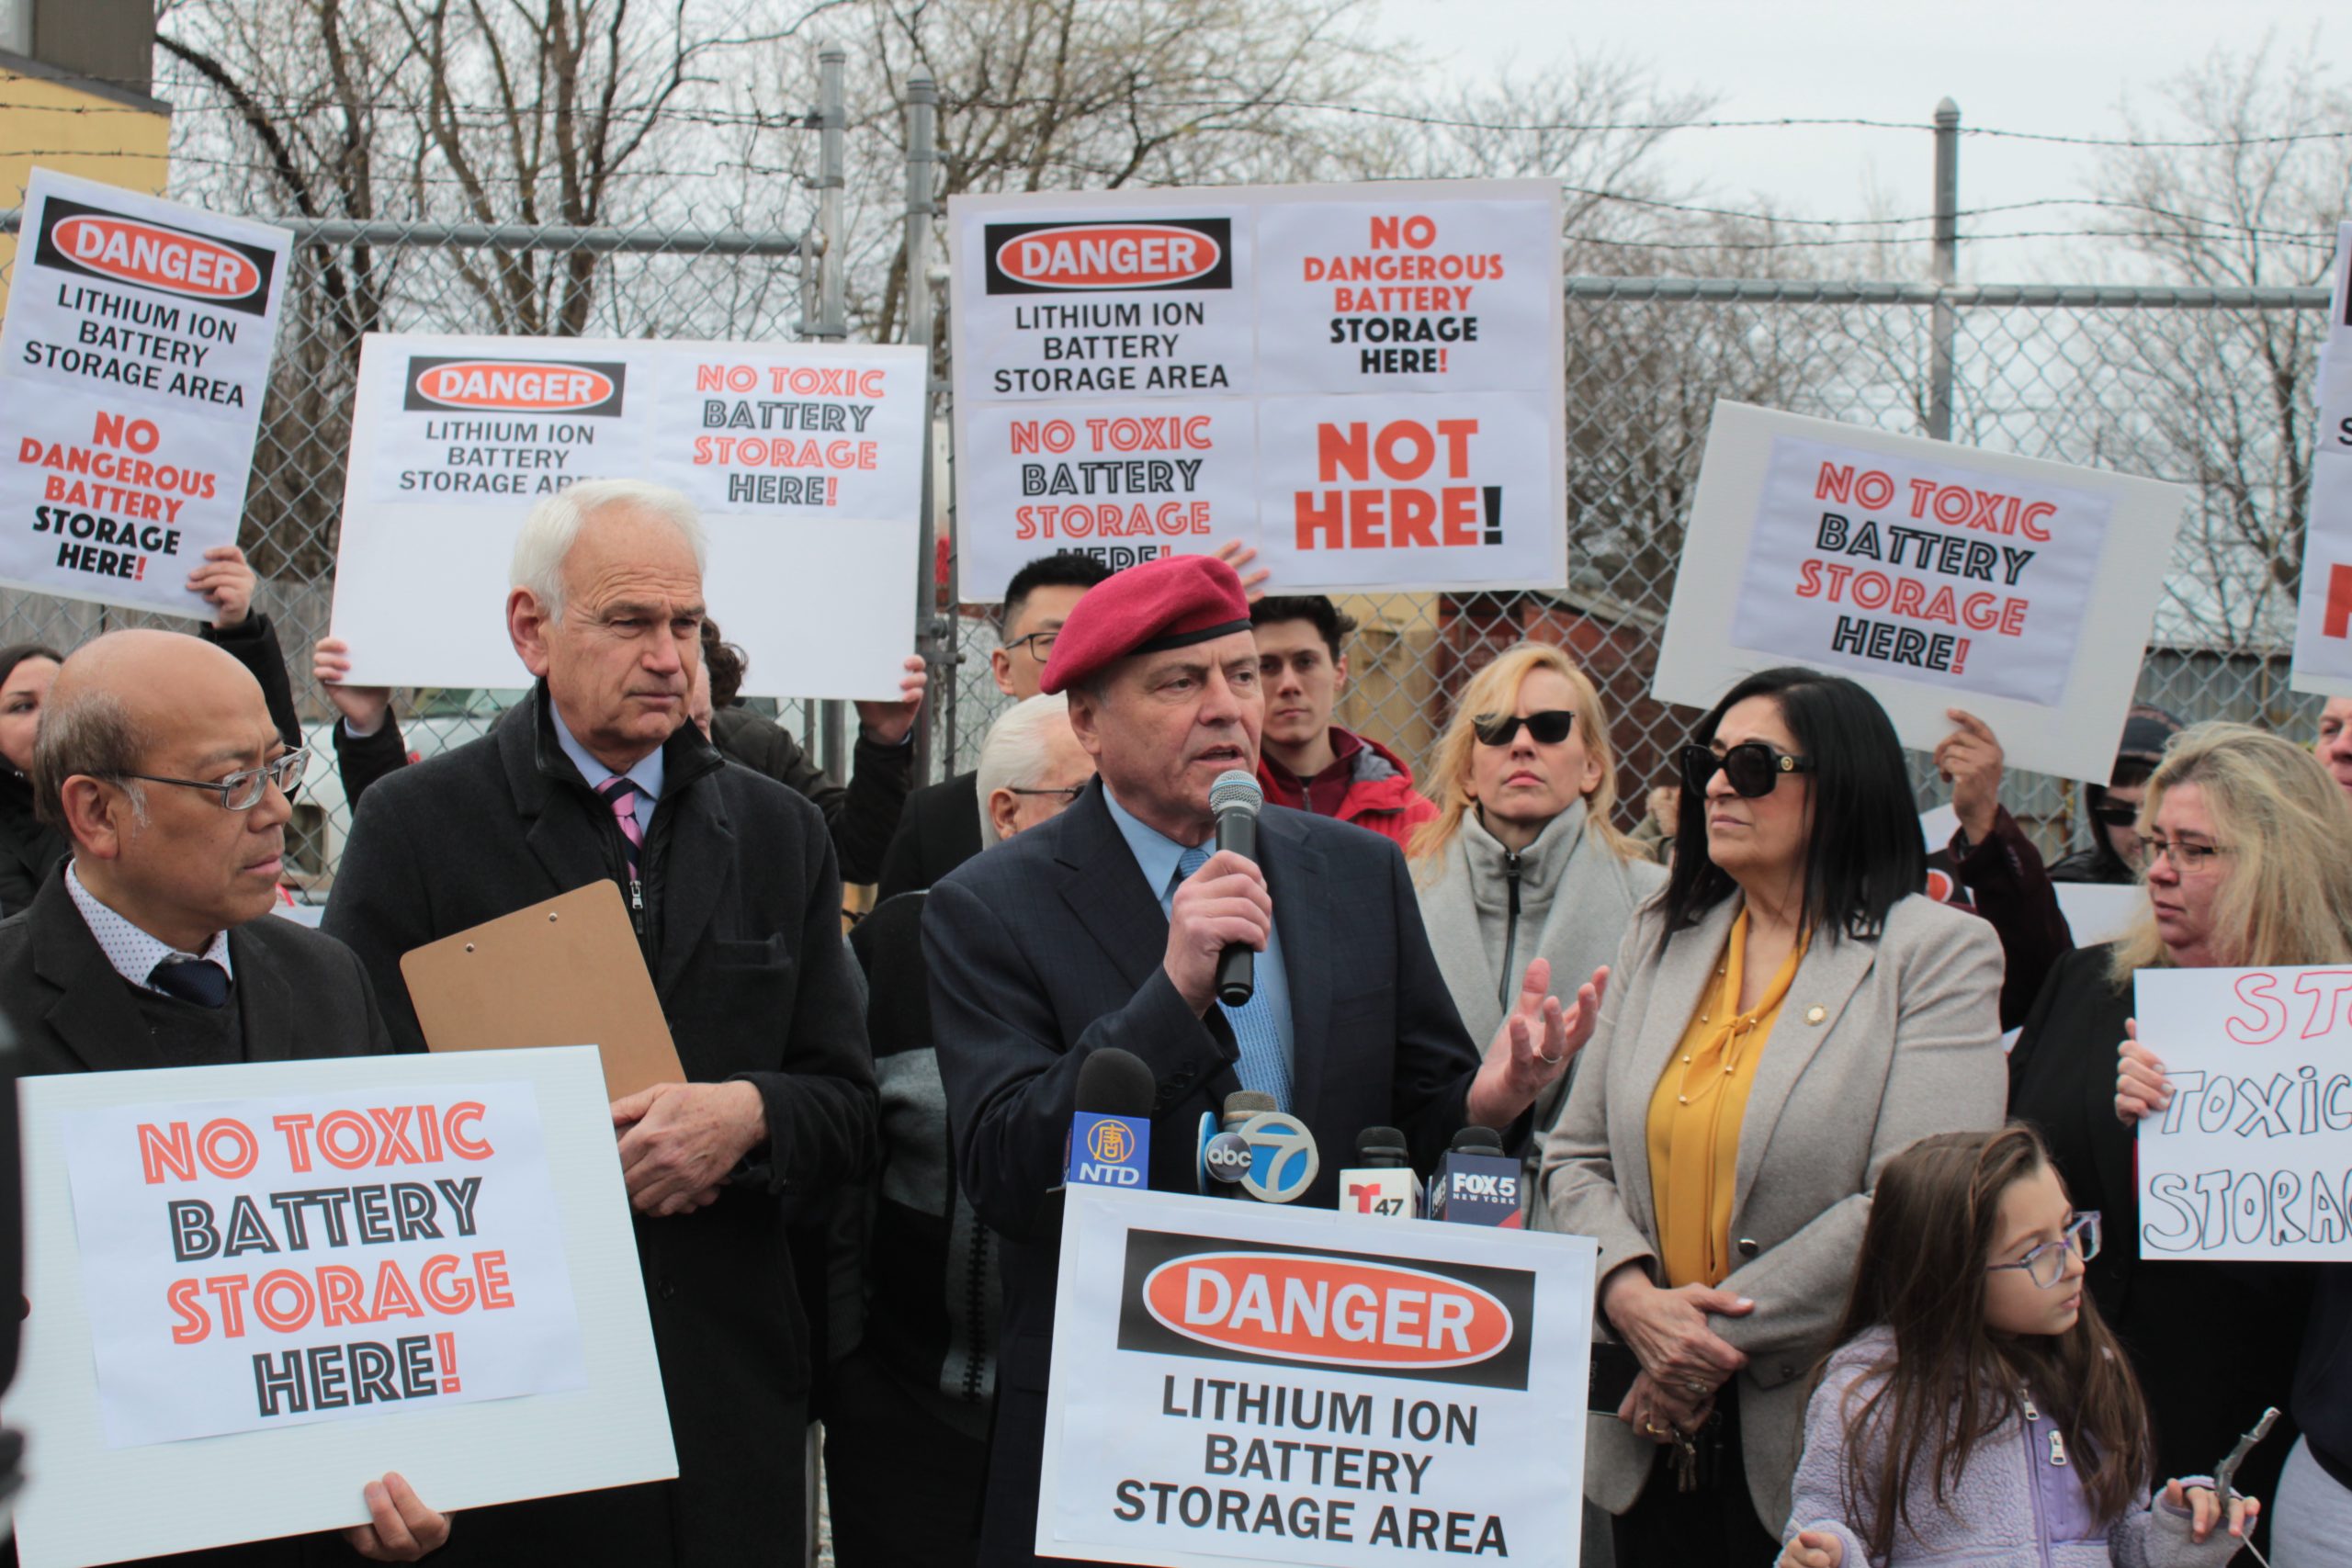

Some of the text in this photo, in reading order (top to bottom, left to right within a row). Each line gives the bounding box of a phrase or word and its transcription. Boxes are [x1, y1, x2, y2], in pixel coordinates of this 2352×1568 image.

[1370, 215, 1436, 250] NO
[74, 222, 241, 292] DANGER
[1021, 239, 1196, 276] DANGER
[1305, 254, 1503, 281] DANGEROUS
[57, 284, 236, 344] LITHIUM ION
[1016, 302, 1204, 329] LITHIUM ION
[1334, 286, 1474, 312] BATTERY
[79, 321, 209, 368] BATTERY
[1044, 334, 1180, 360] BATTERY
[1330, 317, 1476, 344] STORAGE
[23, 341, 243, 408] STORAGE AREA
[994, 365, 1228, 392] STORAGE AREA
[1361, 348, 1447, 373] HERE!
[437, 369, 594, 402] DANGER
[696, 365, 885, 398] NO TOXIC
[93, 412, 160, 454] NO
[426, 421, 594, 445] LITHIUM ION
[703, 400, 874, 433] BATTERY
[1010, 415, 1213, 454] NO TOXIC
[18, 437, 216, 499] DANGEROUS
[447, 447, 569, 469] BATTERY
[693, 436, 876, 469] STORAGE
[1317, 419, 1478, 482] NOT
[400, 470, 605, 494] STORAGE AR
[728, 473, 837, 505] HERE!
[1022, 459, 1202, 496] BATTERY
[45, 475, 184, 524] BATTERY
[1295, 486, 1502, 549] HERE!
[1815, 462, 2058, 542] NO TOXIC
[32, 506, 181, 554] STORAGE
[1016, 502, 1210, 539] STORAGE
[57, 543, 147, 580] HERE!
[1815, 513, 2035, 586] BATTERY
[1796, 558, 2029, 637] STORAGE
[1831, 615, 1971, 674] HERE!
[137, 1101, 495, 1185] NO TOXIC
[1207, 1128, 1312, 1197] abc 7
[1079, 1162, 1139, 1185] NTD
[1374, 1198, 1404, 1216] 47
[1453, 1192, 1515, 1206] NEW YORK
[2143, 1168, 2352, 1252] STORA
[167, 1177, 483, 1262] BATTERY
[166, 1249, 515, 1345] STORAGE
[1183, 1267, 1475, 1352] DANGER
[252, 1331, 461, 1417] HERE!
[1162, 1375, 1477, 1446] LITHIUM ION
[1204, 1434, 1433, 1495] BATTERY
[1114, 1479, 1509, 1557] STORAGE AREA
